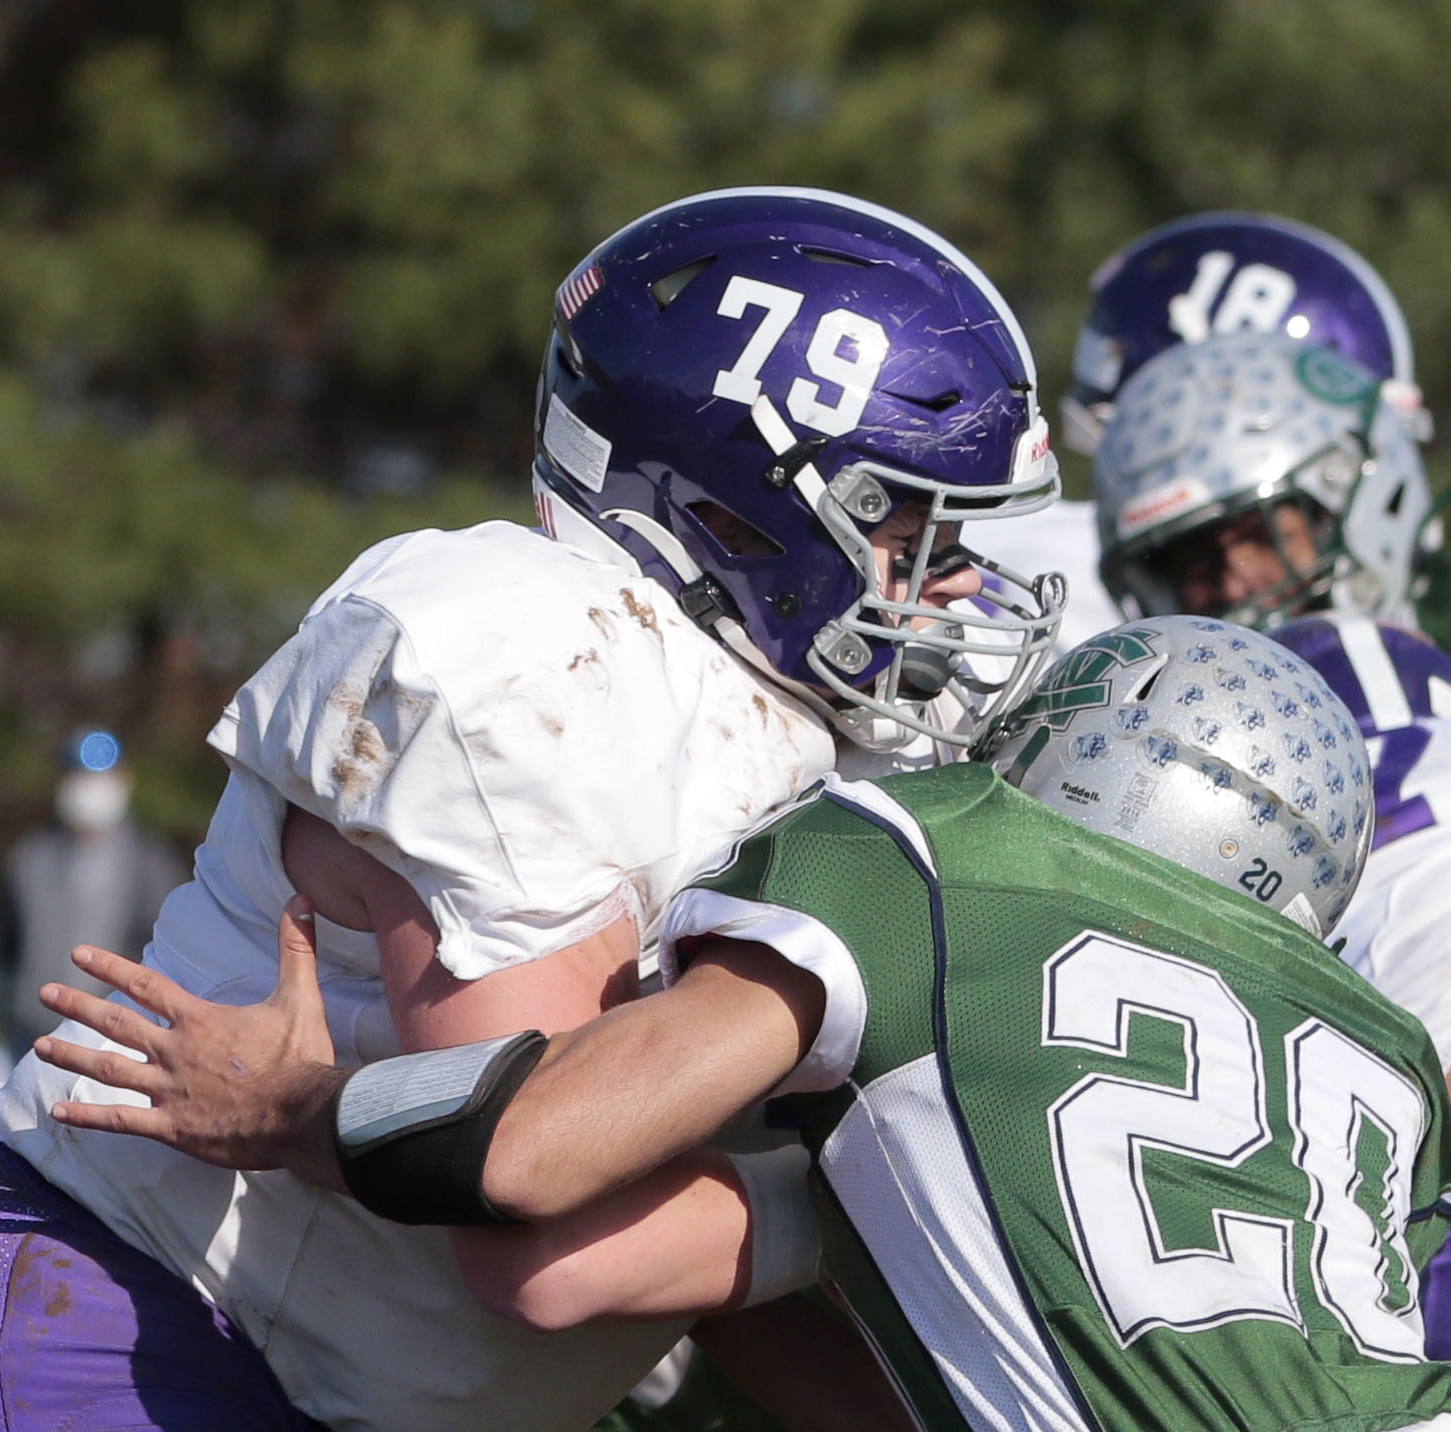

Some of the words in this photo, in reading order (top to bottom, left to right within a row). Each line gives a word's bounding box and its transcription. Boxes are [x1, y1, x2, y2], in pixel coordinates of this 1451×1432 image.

[712, 275, 890, 438] 79
[1061, 781, 1101, 803] Riddell
[1238, 857, 1282, 901] 20
[1041, 928, 1427, 1364] 20
